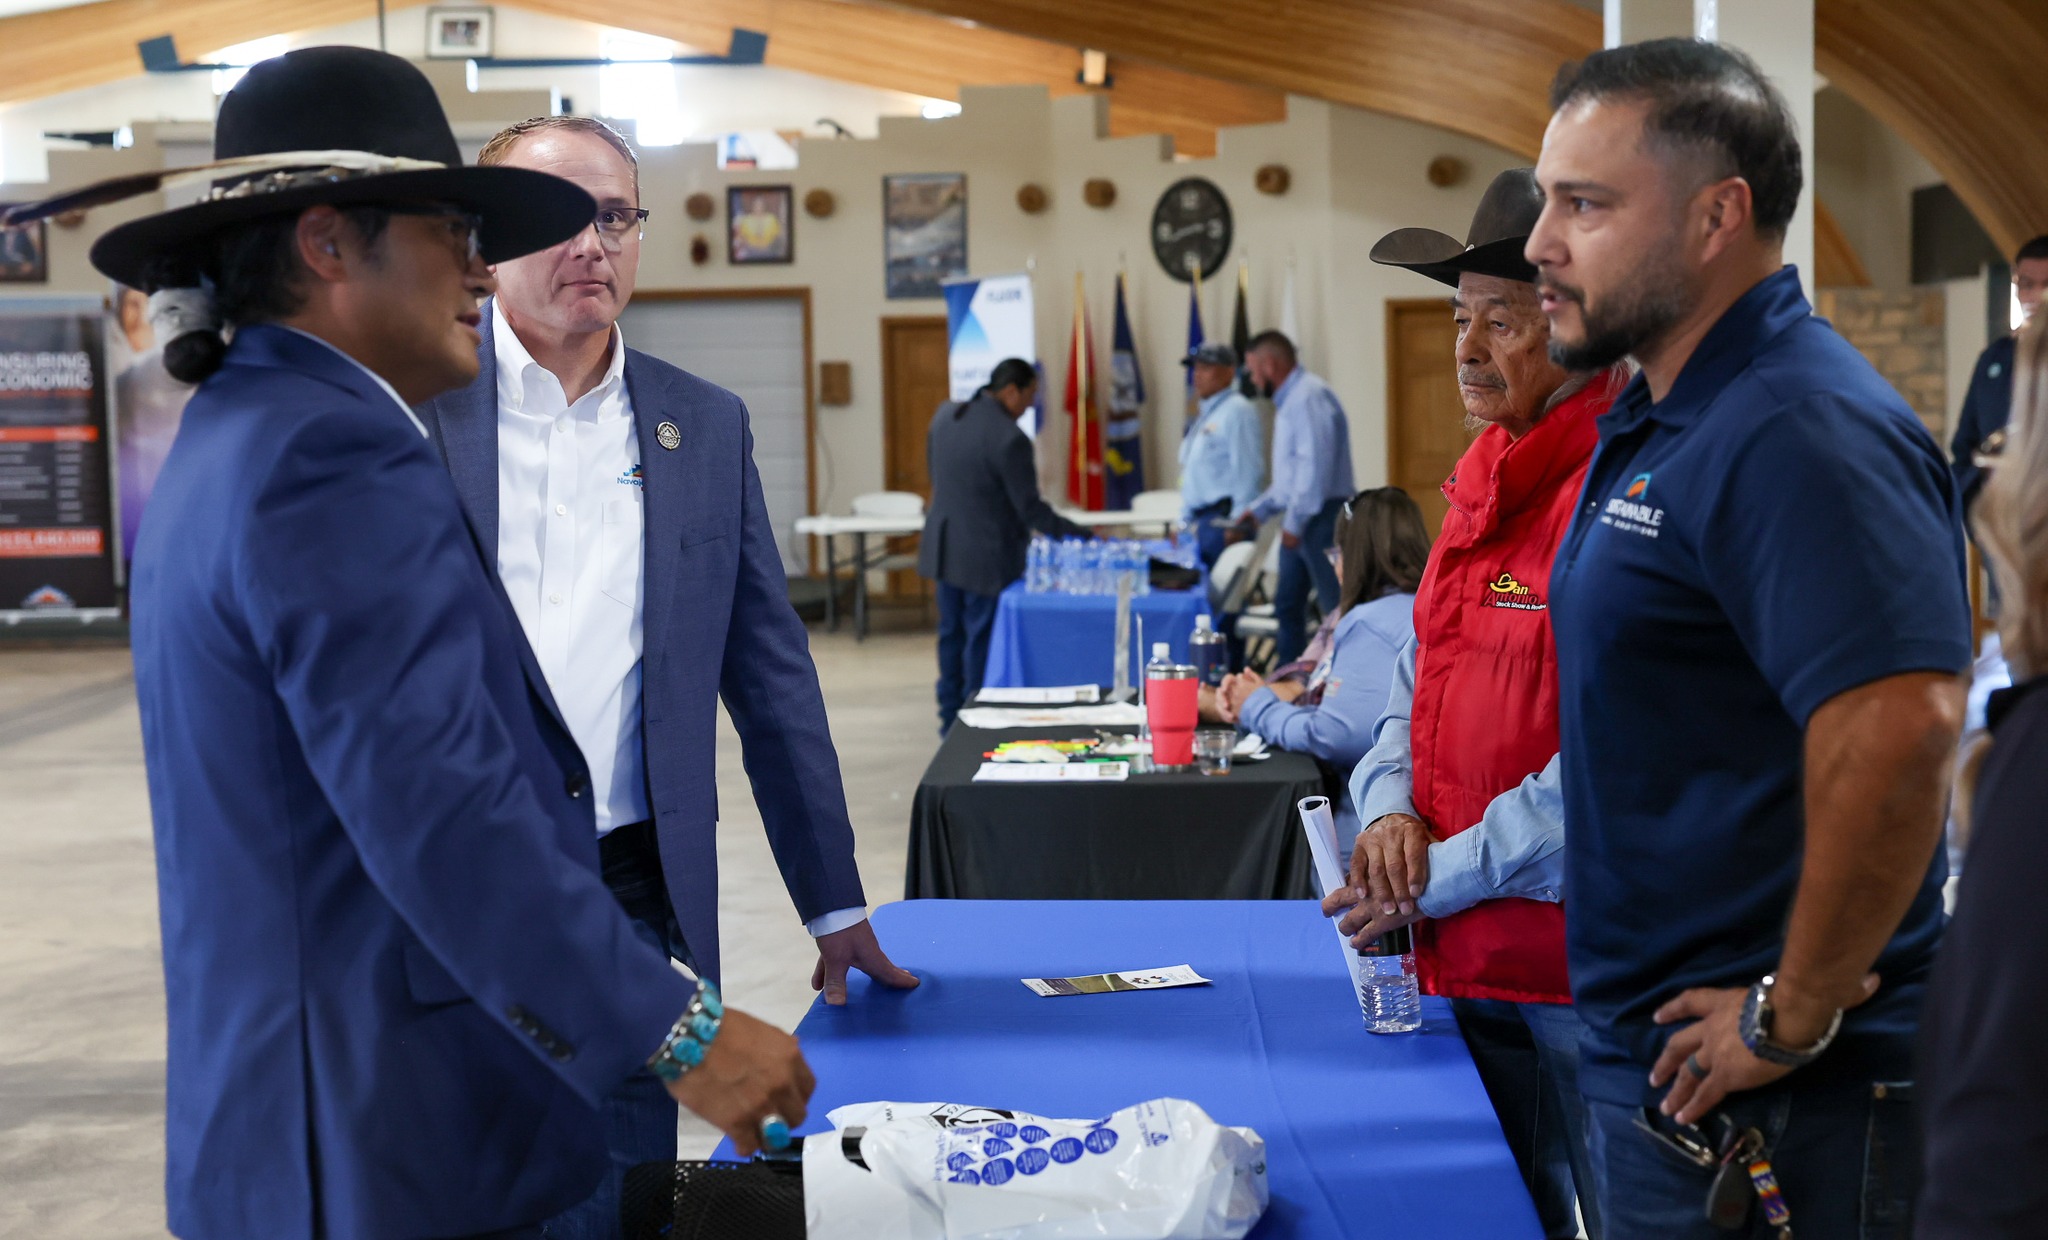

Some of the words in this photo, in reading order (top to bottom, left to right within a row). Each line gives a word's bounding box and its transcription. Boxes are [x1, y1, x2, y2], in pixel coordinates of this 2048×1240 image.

[0, 351, 91, 368] NSURING
[0, 370, 93, 390] CONOMIC
[617, 477, 643, 486] Navaj
[1489, 573, 1529, 595] San
[1484, 591, 1538, 607] Antonio
[1511, 602, 1526, 610] Show
